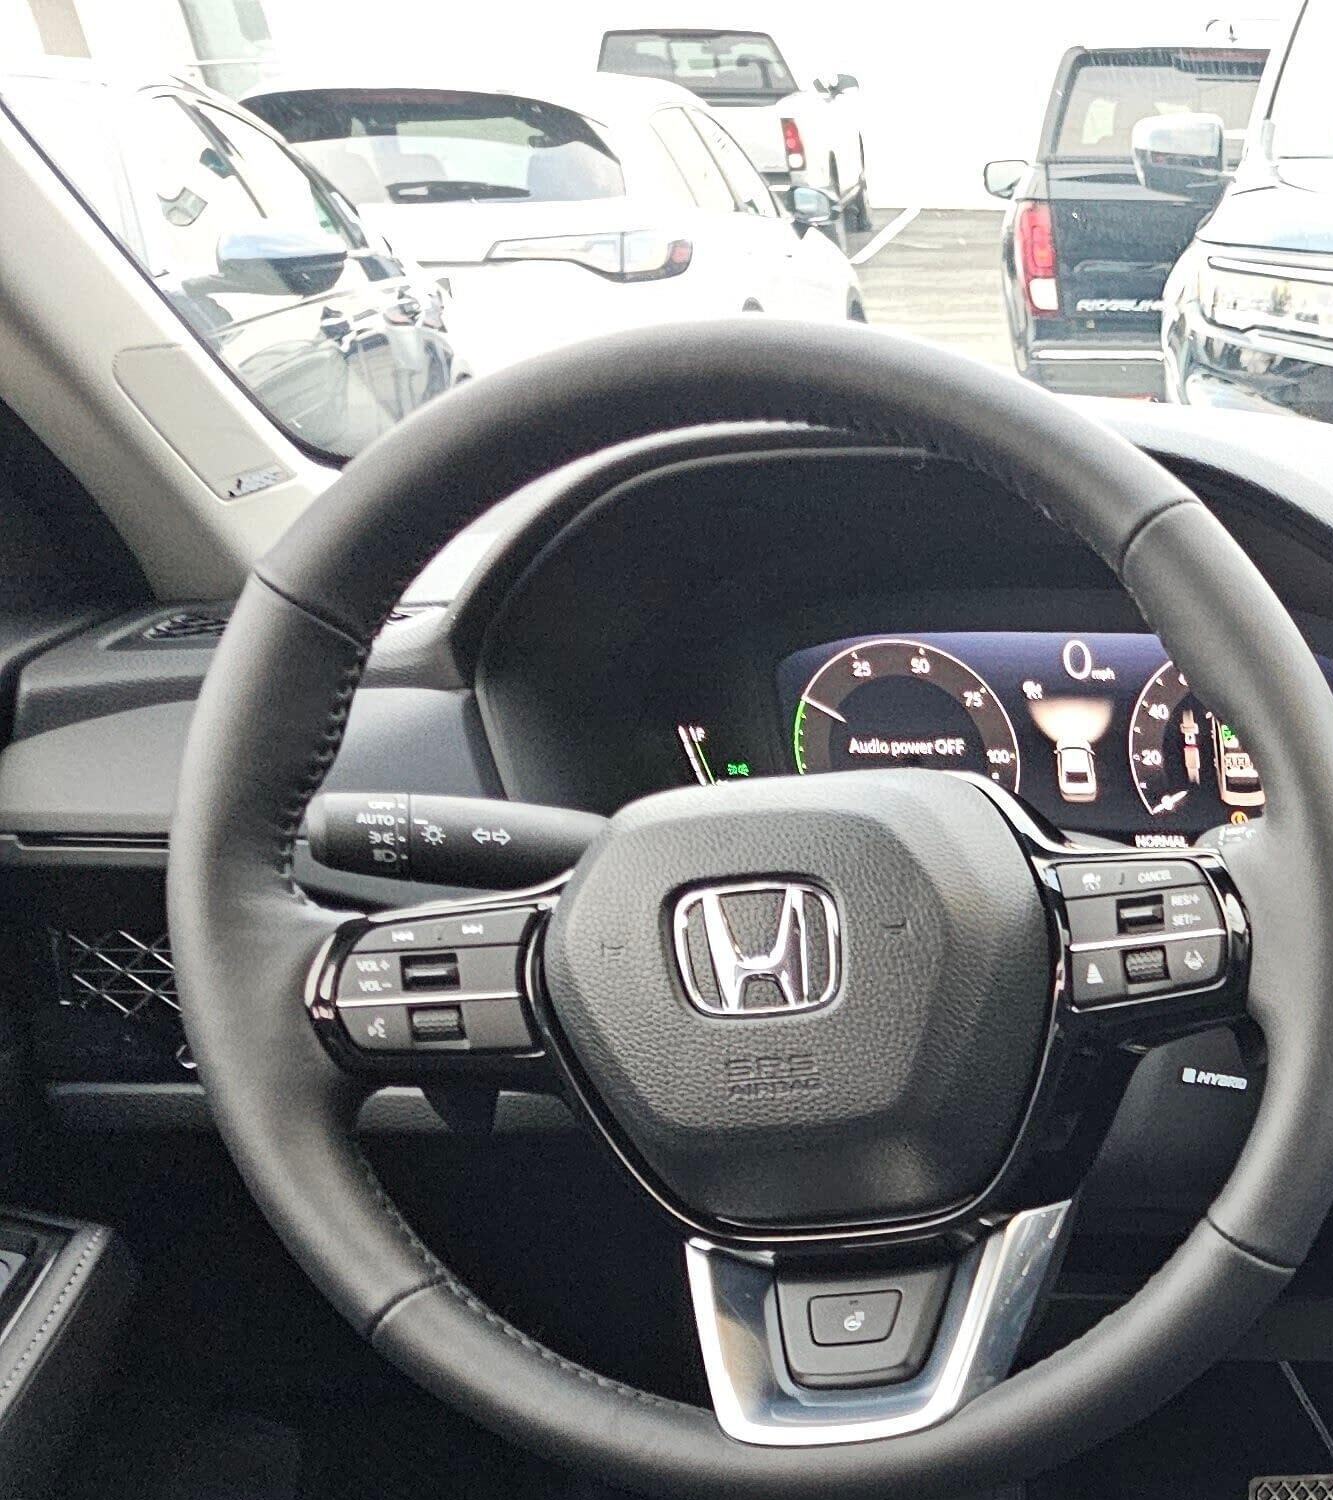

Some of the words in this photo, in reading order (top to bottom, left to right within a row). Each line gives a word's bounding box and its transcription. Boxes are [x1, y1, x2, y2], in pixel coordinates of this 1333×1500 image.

[911, 658, 930, 673] 50
[1063, 639, 1091, 680] 0
[852, 661, 871, 677] 25
[963, 691, 983, 707] 75
[1148, 704, 1169, 720] 40
[849, 738, 889, 754] Audio
[891, 741, 932, 756] power
[934, 738, 965, 755] OFF
[986, 750, 1010, 764] 100
[1142, 750, 1163, 766] 20
[356, 813, 394, 825] AUTO
[1135, 834, 1188, 848] NORMAL
[1137, 870, 1171, 884] CANCEL
[1197, 1070, 1248, 1090] HYBRID
